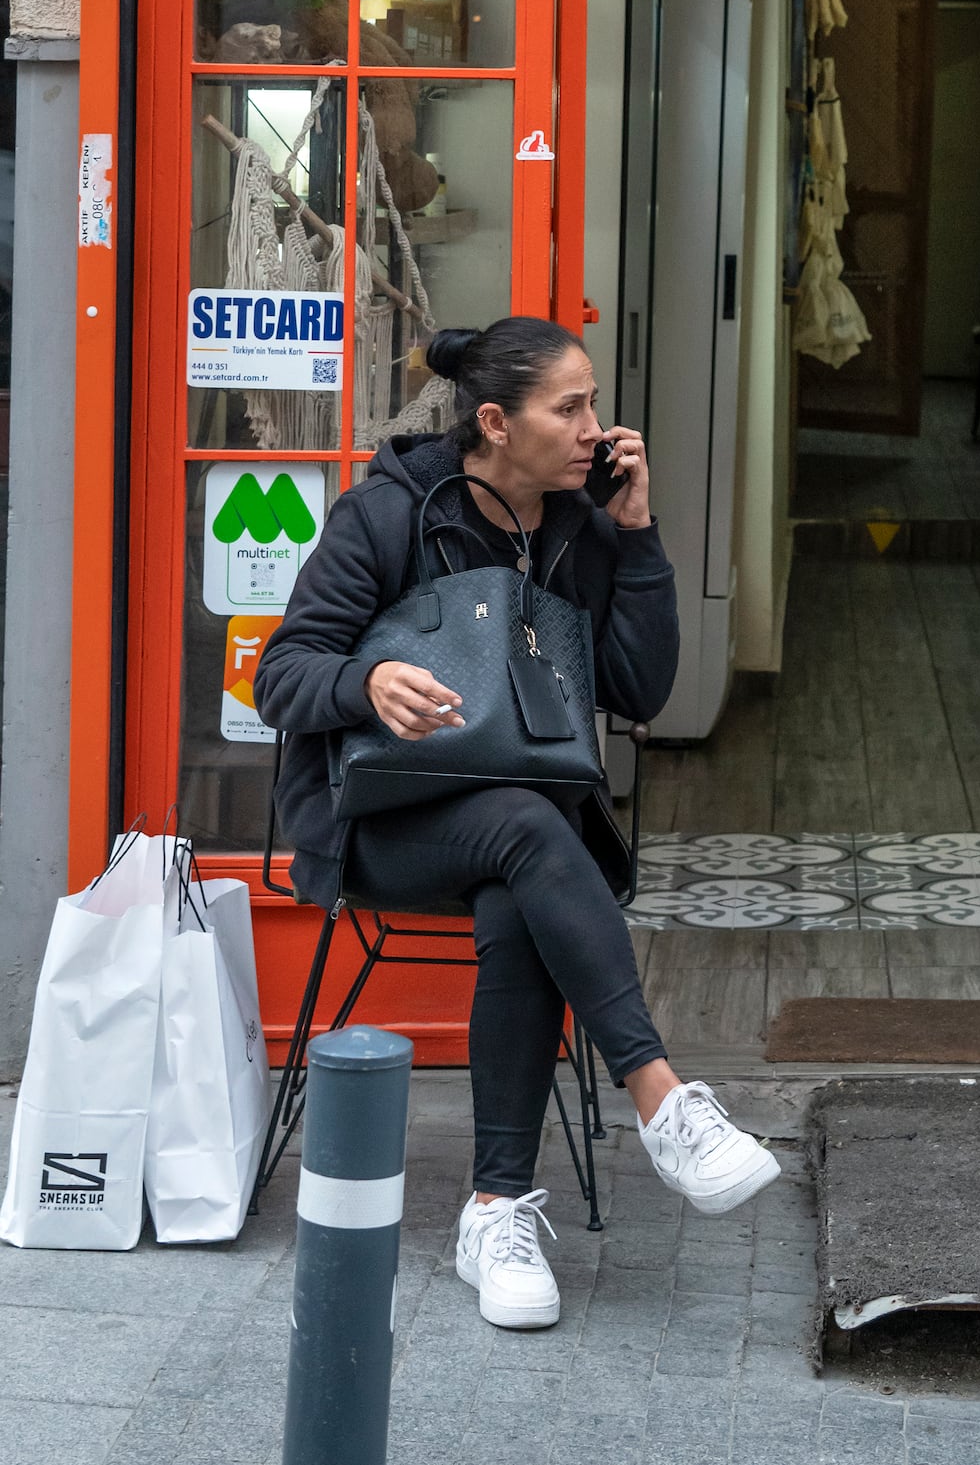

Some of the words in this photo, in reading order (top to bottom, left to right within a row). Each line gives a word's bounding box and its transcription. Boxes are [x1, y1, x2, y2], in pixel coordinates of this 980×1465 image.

[192, 295, 344, 342] SETCARD
[268, 346, 287, 355] Yemek
[192, 373, 269, 382] www.setcard.com.tr
[237, 547, 290, 559] multinet
[40, 1192, 87, 1205] SNEAKS
[89, 1193, 104, 1205] UP
